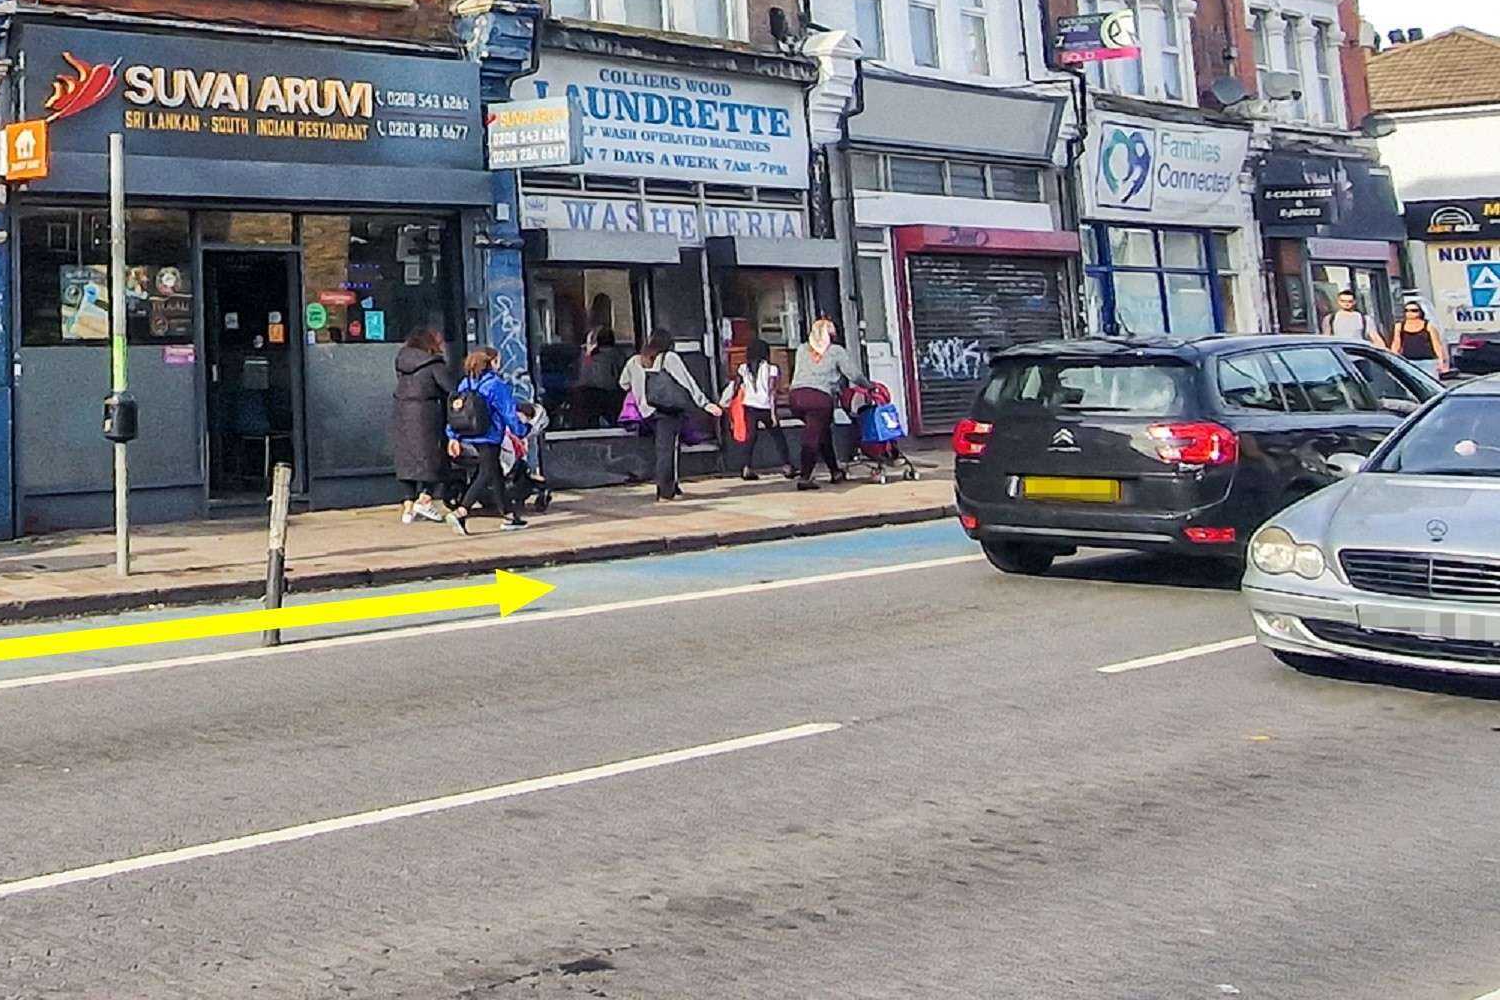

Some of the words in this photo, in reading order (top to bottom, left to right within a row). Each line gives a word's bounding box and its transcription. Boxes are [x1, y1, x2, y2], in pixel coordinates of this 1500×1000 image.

[124, 65, 249, 112] SUVAI
[255, 75, 374, 119] ARUVI
[600, 68, 681, 91] COLLIERS
[686, 79, 732, 97] WOOD
[418, 93, 440, 108] 543
[125, 111, 146, 129] SRI
[149, 112, 200, 132] LANKAN
[211, 115, 249, 136] SOUTH
[256, 119, 295, 138] INDIAN
[298, 121, 370, 141] RESTAURANT
[388, 120, 417, 138] 0208
[601, 126, 637, 140] WASH
[641, 130, 708, 147] OPERATED
[710, 137, 772, 153] MACHINES
[599, 148, 607, 161] 7
[613, 149, 655, 165] DAYS
[660, 153, 670, 166] A
[673, 154, 719, 170] WEEK
[1161, 132, 1221, 161] Families
[1158, 162, 1232, 192] Connected
[562, 199, 797, 240] WASHETERIA
[1438, 246, 1492, 262] NOW
[1456, 311, 1495, 322] MOT
